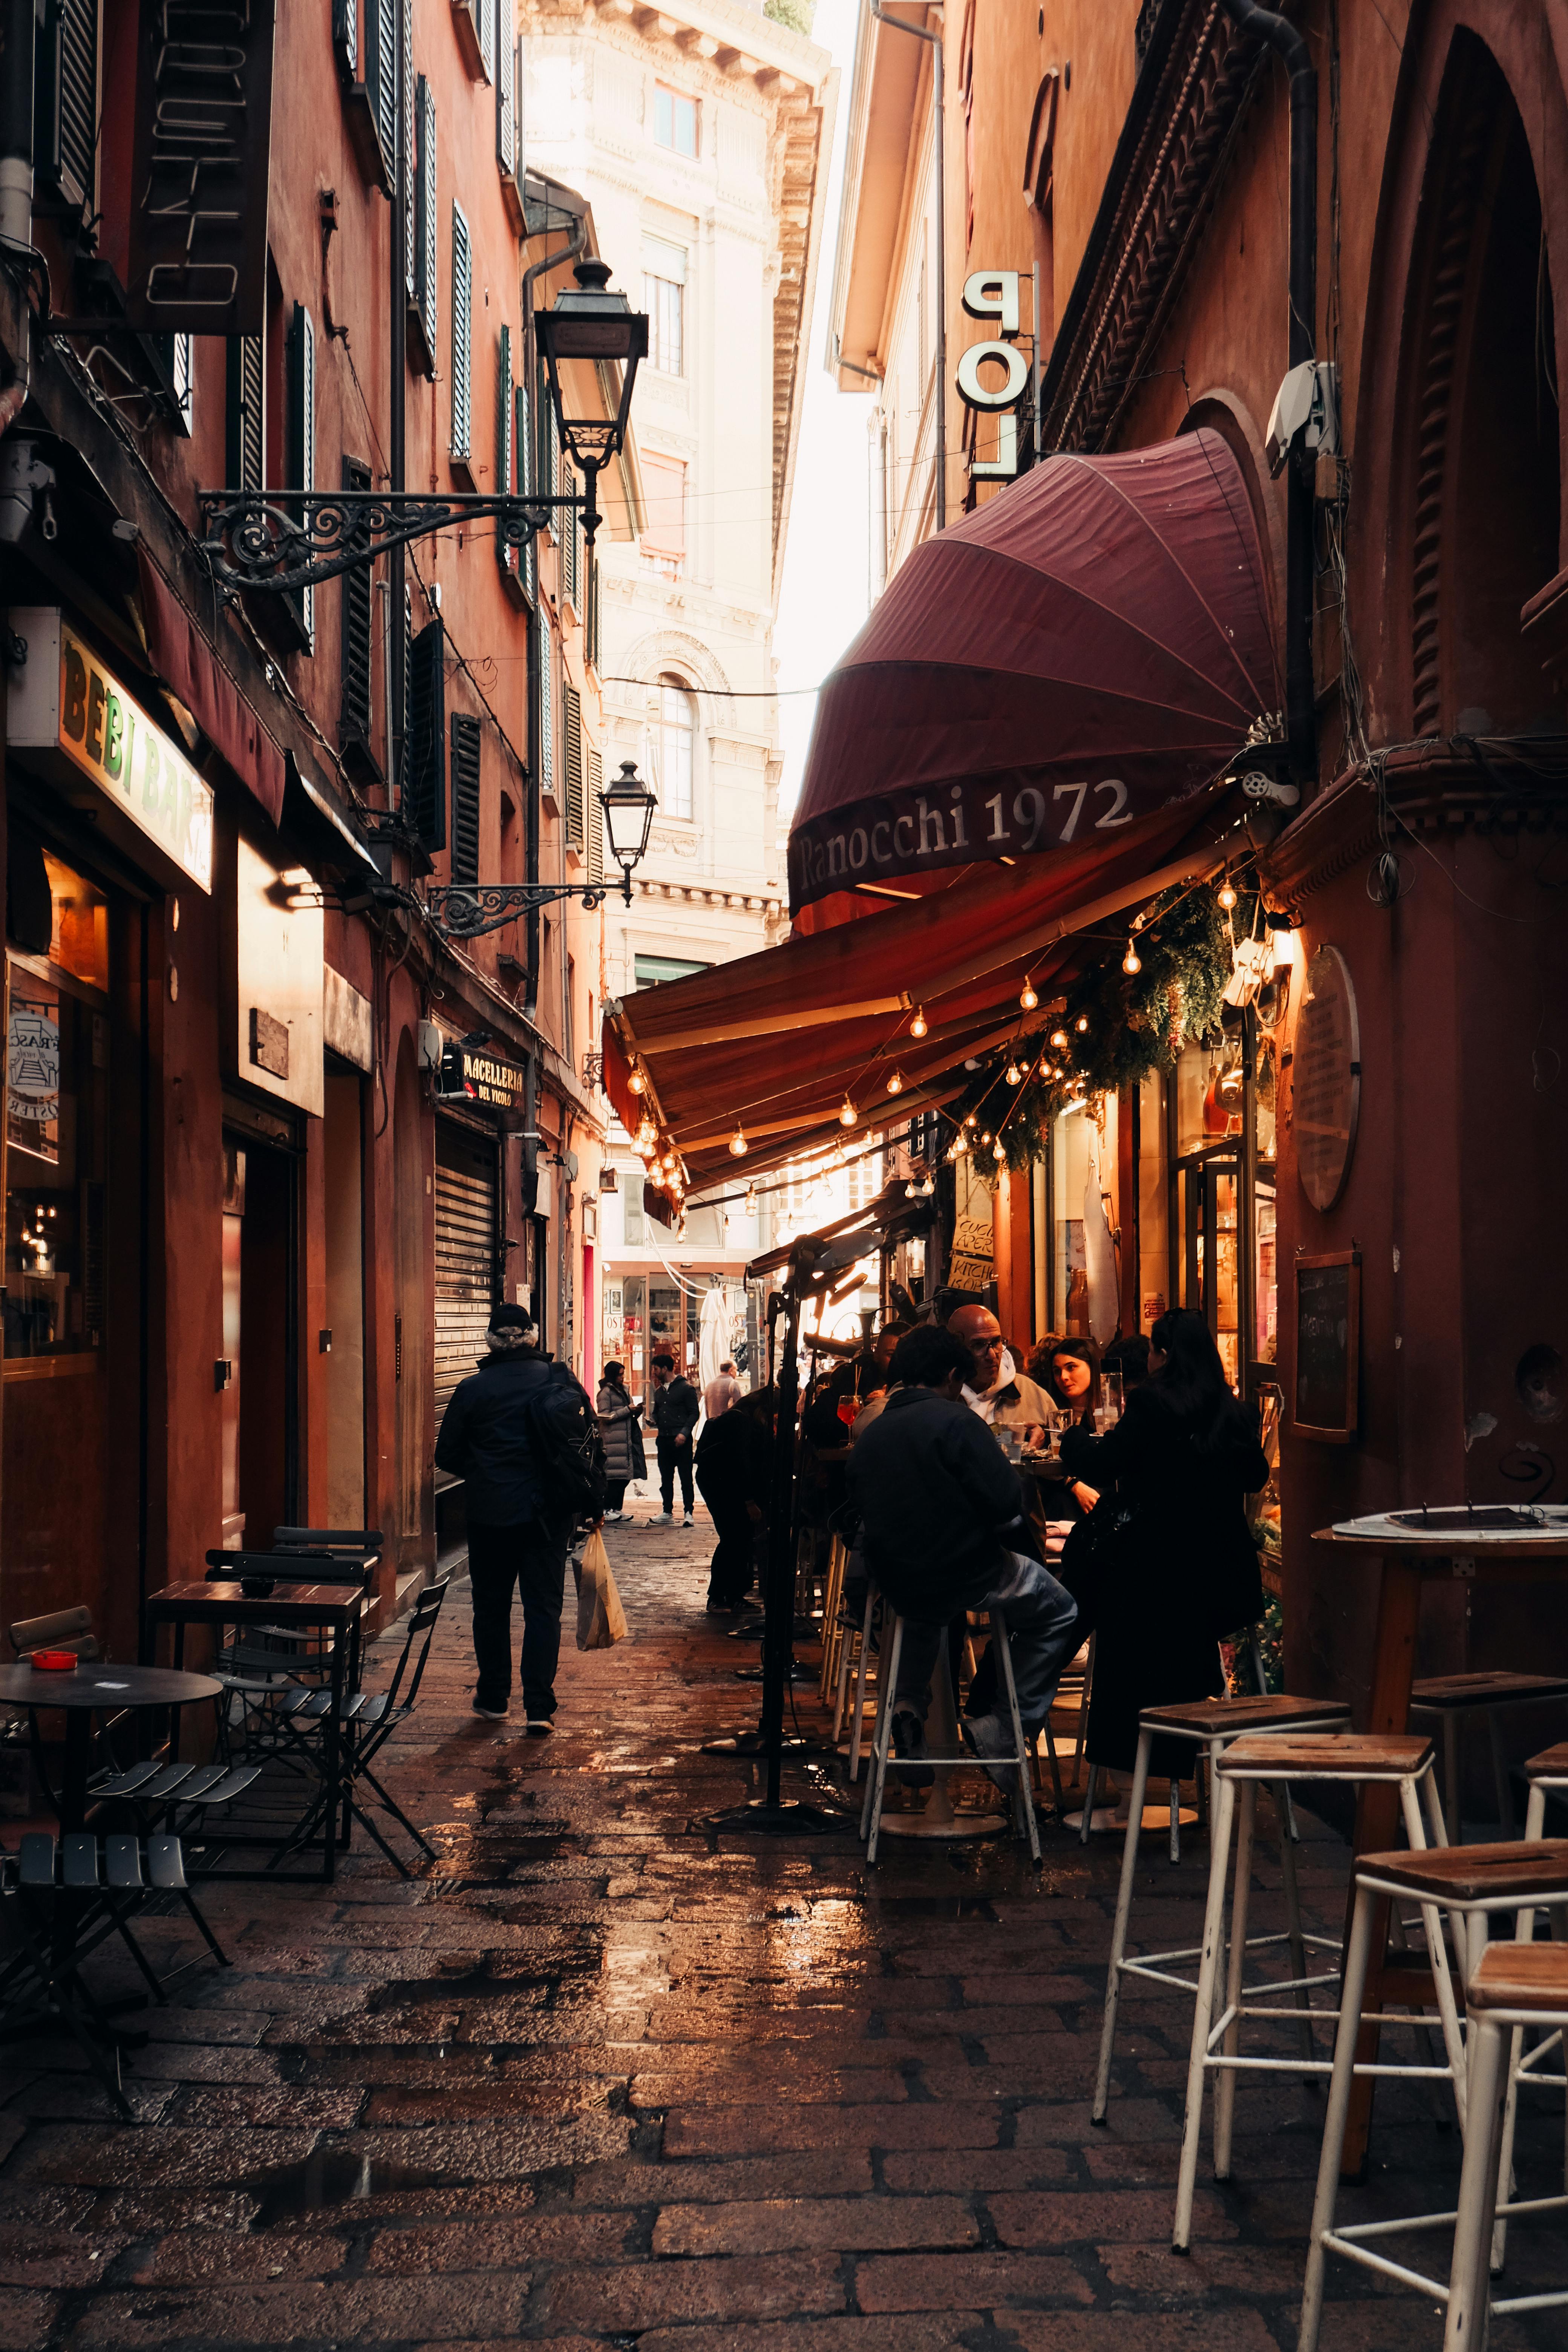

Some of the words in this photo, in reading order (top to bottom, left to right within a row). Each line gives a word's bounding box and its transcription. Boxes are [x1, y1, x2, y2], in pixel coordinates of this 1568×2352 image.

[63, 639, 135, 797] BEBI
[141, 730, 193, 856] BAR
[801, 786, 969, 891] Ranocchi
[985, 779, 1133, 851] 1972
[464, 1054, 523, 1093] MACELLERIA
[479, 1084, 490, 1101] DEL
[492, 1089, 511, 1107] VICOLO
[963, 1278, 982, 1291] OP
